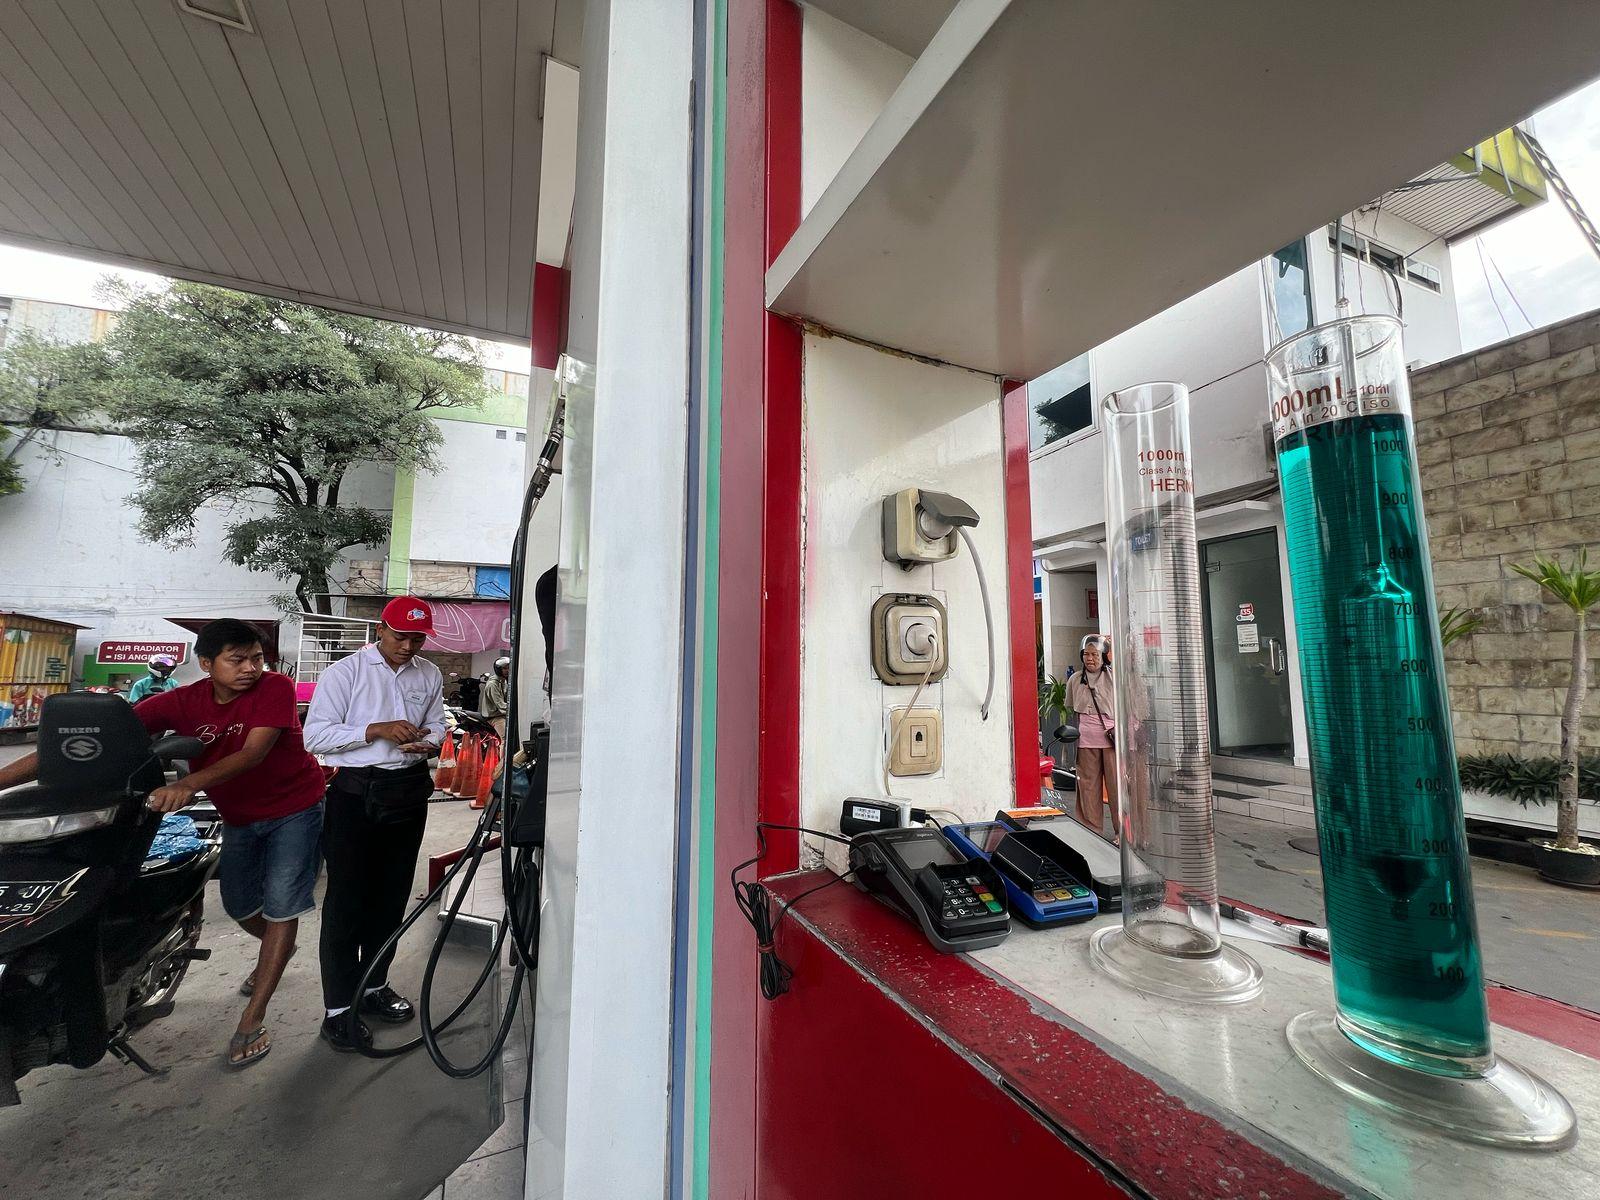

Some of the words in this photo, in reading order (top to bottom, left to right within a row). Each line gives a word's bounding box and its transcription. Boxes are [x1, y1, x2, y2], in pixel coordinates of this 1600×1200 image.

[1321, 405, 1338, 419] 20
[1373, 439, 1404, 452] 1000
[1139, 467, 1164, 476] Class
[1382, 492, 1408, 505] 900
[1401, 658, 1427, 673] 600
